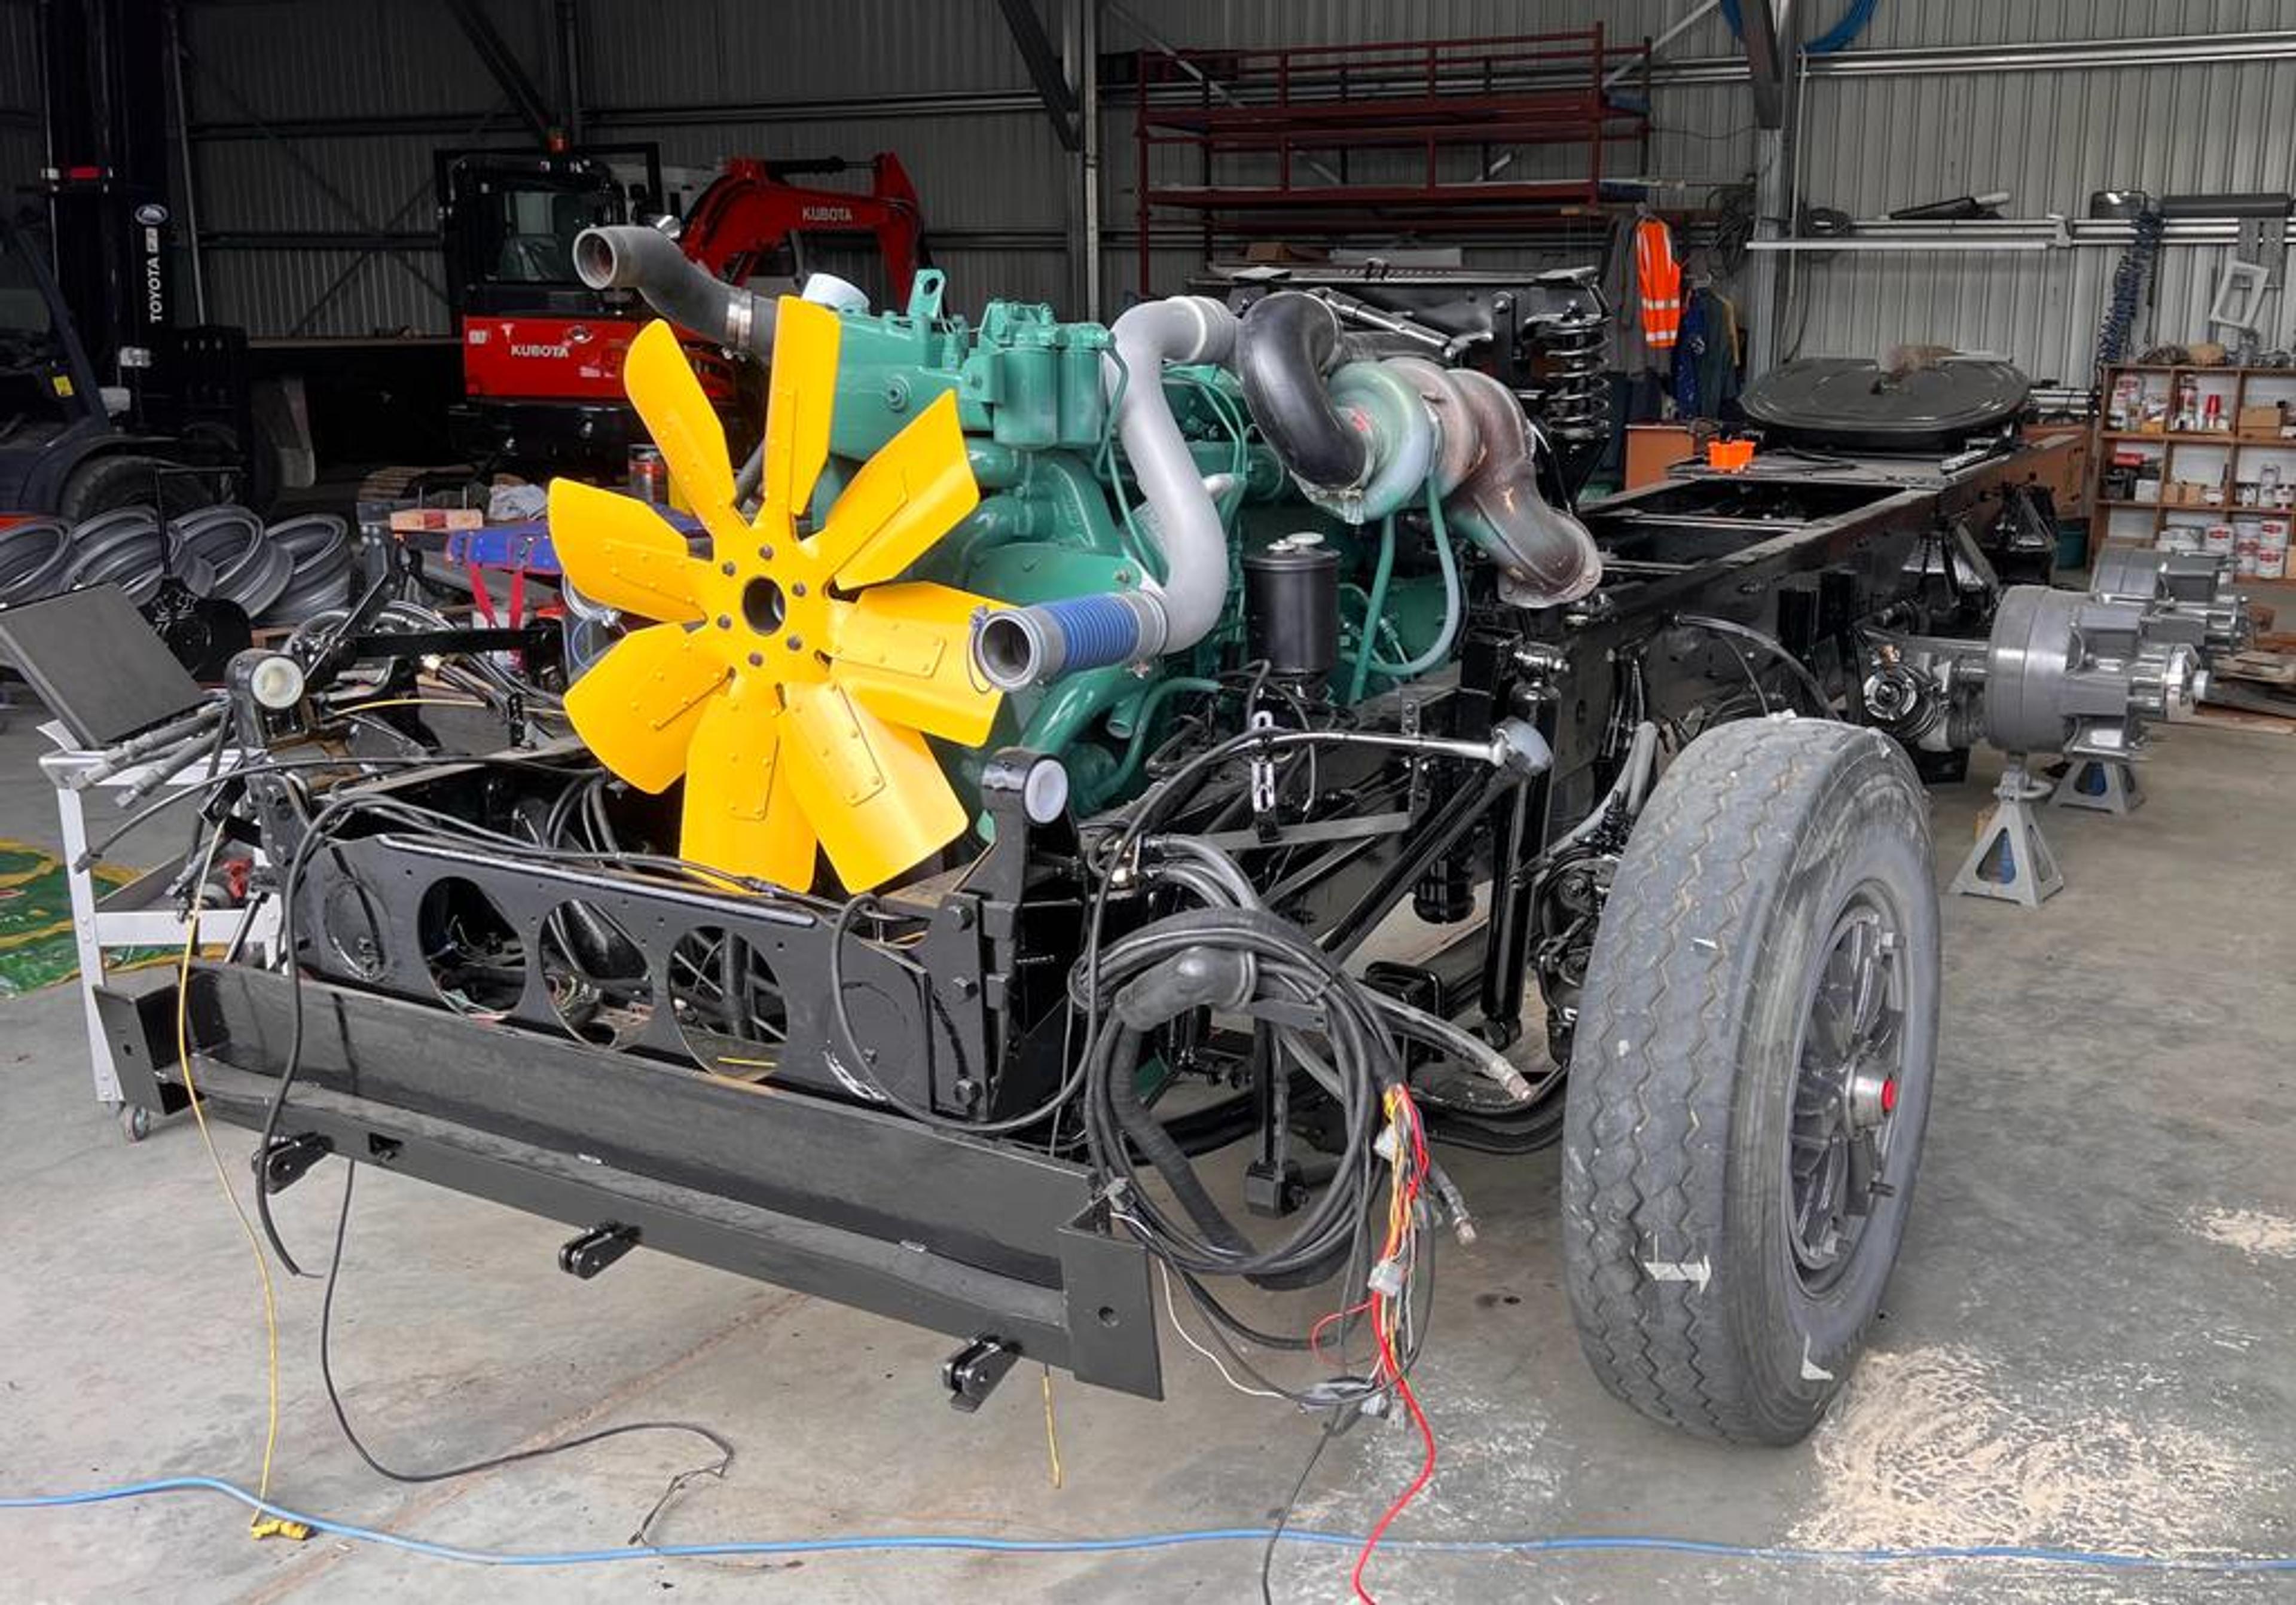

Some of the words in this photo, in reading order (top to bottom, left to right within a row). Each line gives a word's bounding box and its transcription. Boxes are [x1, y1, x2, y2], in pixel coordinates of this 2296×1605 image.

[802, 206, 853, 222] KUBOTA
[147, 256, 163, 323] TOYOTA
[511, 344, 569, 357] KUBOTA
